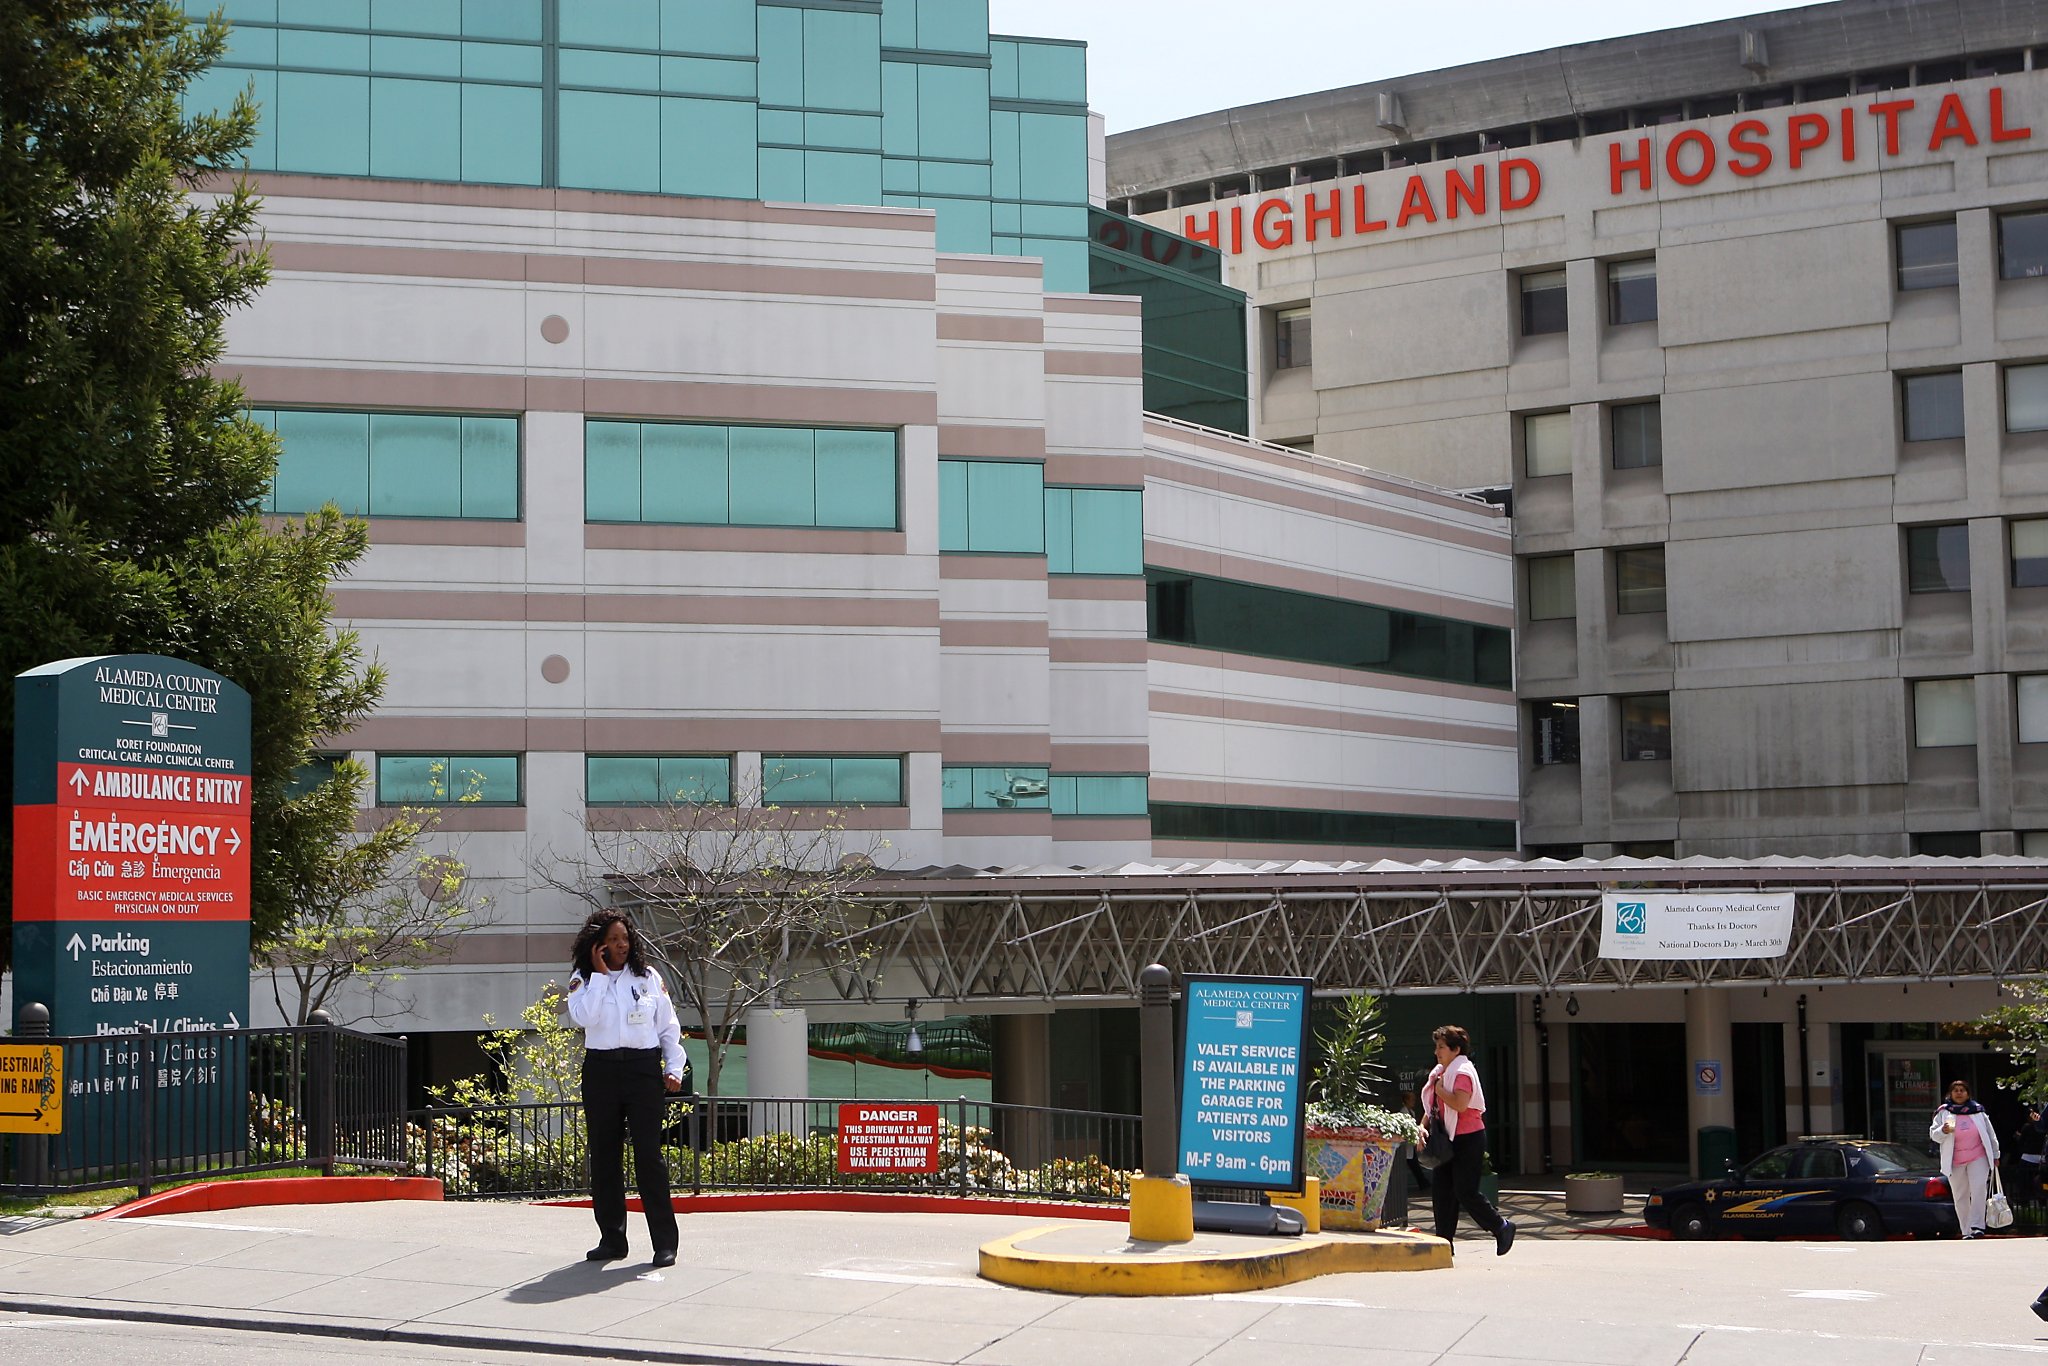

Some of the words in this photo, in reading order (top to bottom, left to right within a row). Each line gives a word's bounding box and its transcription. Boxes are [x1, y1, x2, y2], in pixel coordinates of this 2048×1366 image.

[1184, 157, 1541, 254] HIGHLAND
[1610, 88, 2031, 195] HOSPITAL
[95, 666, 164, 689] ALAMEDA
[166, 674, 221, 695] COUNTY
[100, 687, 163, 708] MEDICAL
[165, 694, 216, 713] CENTER
[116, 738, 144, 750] KORET
[146, 741, 202, 754] FOUNDATION
[79, 748, 118, 761] CRITICAL
[120, 751, 142, 762] CARE
[144, 753, 162, 764] AND
[165, 755, 202, 767] CLINICAL
[205, 758, 234, 770] CENTER
[94, 771, 190, 801] AMBULANCE
[196, 777, 242, 804] ENTRY
[69, 820, 220, 855] EMERGENCY
[69, 858, 90, 880] Cấp
[94, 860, 114, 877] Cứu
[121, 860, 146, 878] 急診
[152, 862, 221, 884] Emergencia
[77, 890, 103, 900] BASIC
[106, 891, 156, 901] EMERGENCY
[159, 892, 194, 902] MEDICAL
[197, 892, 234, 902] SERVICES
[114, 903, 158, 914] PHYSICIAN
[162, 904, 176, 914] ON
[178, 904, 200, 914] DUTY
[1696, 904, 1723, 914] County
[1725, 904, 1754, 912] Medical
[1756, 903, 1780, 912] Center
[1687, 922, 1714, 930] Thanks
[1717, 922, 1726, 930] Its
[1729, 922, 1758, 930] Doctors
[91, 932, 150, 956] Parking
[1693, 940, 1722, 948] Doctors
[1723, 940, 1738, 950] Day
[1745, 939, 1768, 948] March
[1769, 938, 1782, 946] 30th
[91, 959, 192, 976] Estacionamiento
[113, 987, 132, 1004] Đậu
[135, 987, 148, 1000] Xe
[154, 982, 178, 1000] 停車
[1196, 989, 1250, 1000] ALAMEDA
[1253, 991, 1299, 1001] COUNTY
[1203, 999, 1248, 1009] MEDICAL
[1250, 1000, 1290, 1010] CENTER
[96, 1019, 156, 1036] Hospil
[1198, 1043, 1238, 1056] VALET
[1241, 1045, 1296, 1058] SERVICE
[1193, 1060, 1205, 1072] IS
[1208, 1061, 1278, 1075] AVAILABLE
[1281, 1063, 1294, 1076] IN
[1400, 1071, 1414, 1080] EXIT
[22, 1078, 56, 1094] RAMS
[1200, 1077, 1225, 1090] THE
[1229, 1078, 1286, 1093] PARKING
[1400, 1082, 1415, 1091] ONLY
[1201, 1094, 1253, 1108] GARAGE
[1257, 1096, 1282, 1110] FOR
[860, 1110, 918, 1121] DANGER
[1197, 1111, 1258, 1126] PATIENTS
[1261, 1113, 1288, 1126] AND
[845, 1125, 862, 1134] THIS
[865, 1125, 904, 1134] DRIVEWAY
[906, 1125, 914, 1134] IS
[917, 1125, 932, 1134] NOT
[1212, 1128, 1271, 1144] VISITORS
[843, 1135, 848, 1144] A
[851, 1135, 896, 1144] PEDESTRIAN
[898, 1135, 934, 1144] WALKWAY
[850, 1146, 868, 1156] USE
[871, 1147, 926, 1157] PEDESTRIAN
[850, 1157, 890, 1168] WALKING
[894, 1157, 926, 1168] RAMPS
[1186, 1152, 1212, 1167] M-F
[1216, 1154, 1247, 1170] 9am
[1259, 1155, 1292, 1174] 6pm
[1722, 1189, 1782, 1199] SHERIFF
